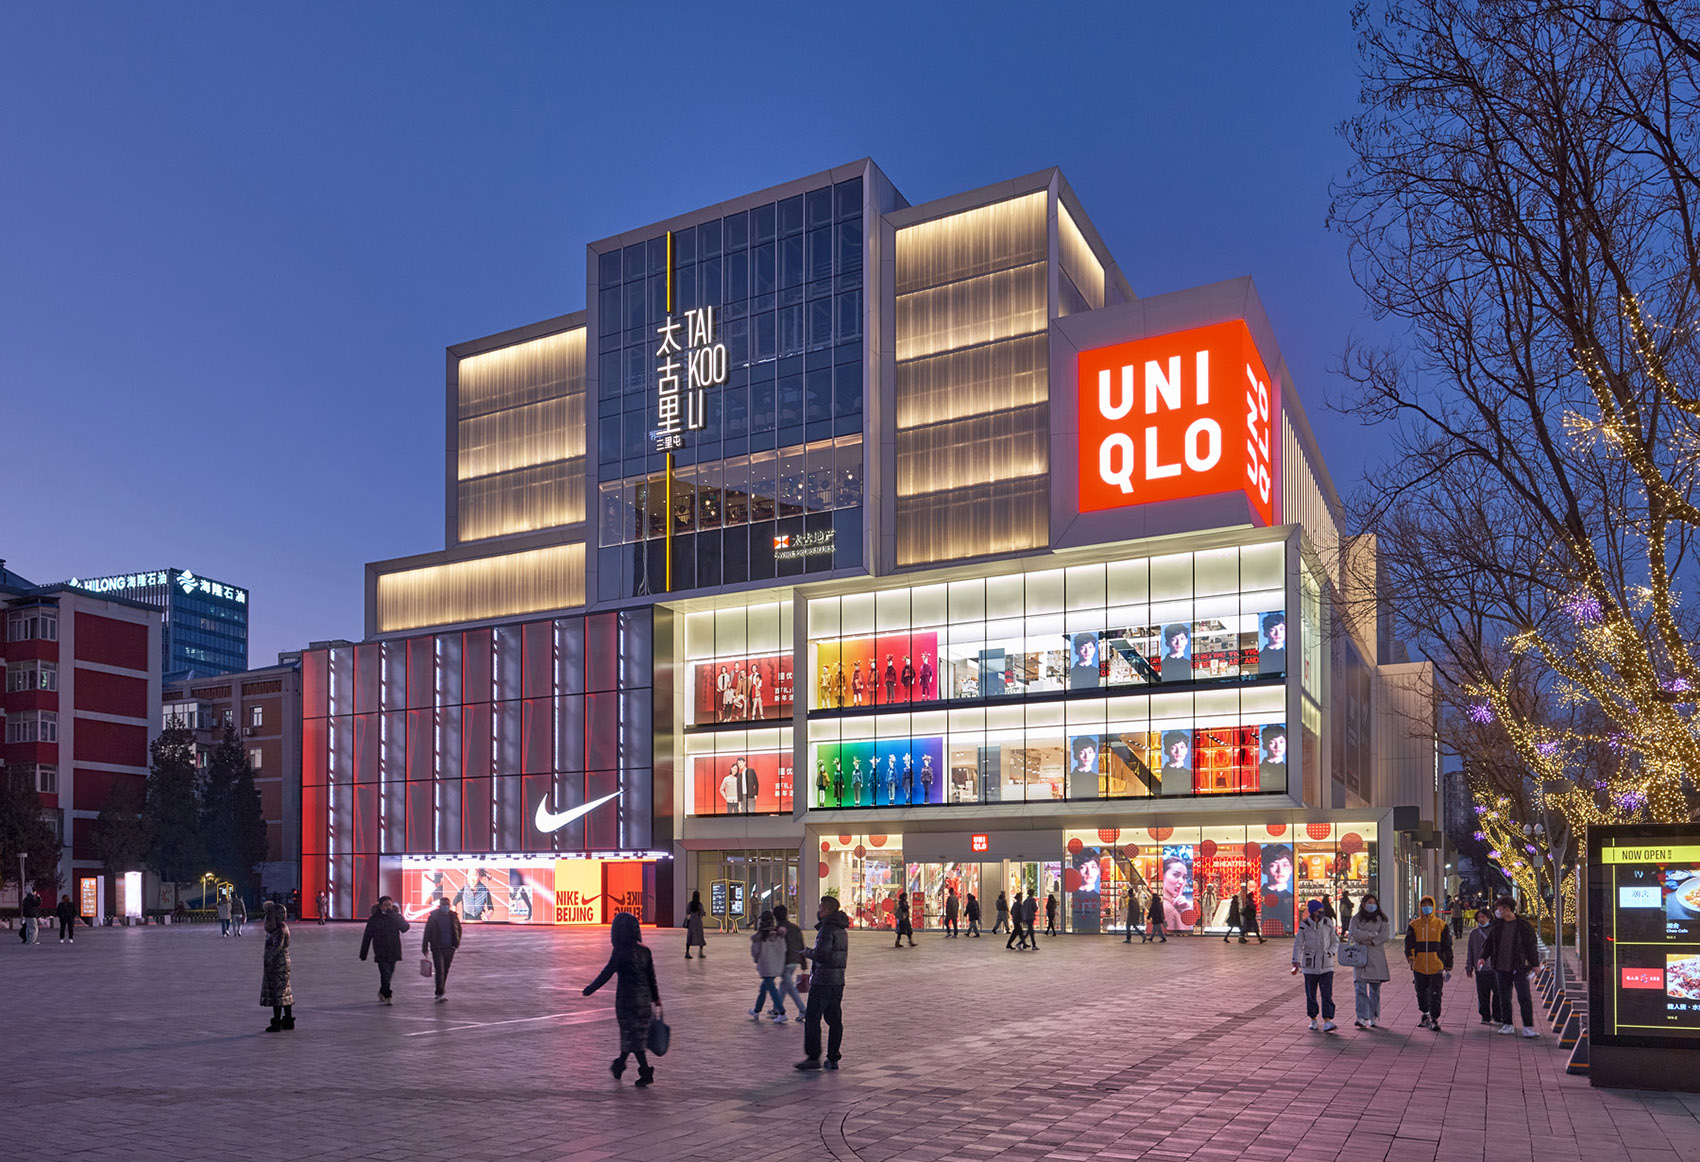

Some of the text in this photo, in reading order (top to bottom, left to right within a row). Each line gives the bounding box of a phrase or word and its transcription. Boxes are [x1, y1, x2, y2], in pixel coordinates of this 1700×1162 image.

[684, 305, 712, 348] TAI
[656, 316, 682, 435] 太古里
[688, 343, 726, 389] KOO
[1099, 350, 1209, 420] UNI
[688, 389, 703, 429] LI
[1246, 363, 1258, 486] UNI
[656, 434, 681, 451] 三里屯
[1099, 417, 1222, 494] QLO
[1258, 381, 1270, 504] QLO
[126, 571, 167, 588] 海隆石油
[200, 579, 246, 603] 海隆石油
[1622, 850, 1642, 860] NOW
[1644, 849, 1666, 860] OPEN
[556, 891, 579, 906] NIKE
[556, 907, 594, 922] BEIJING
